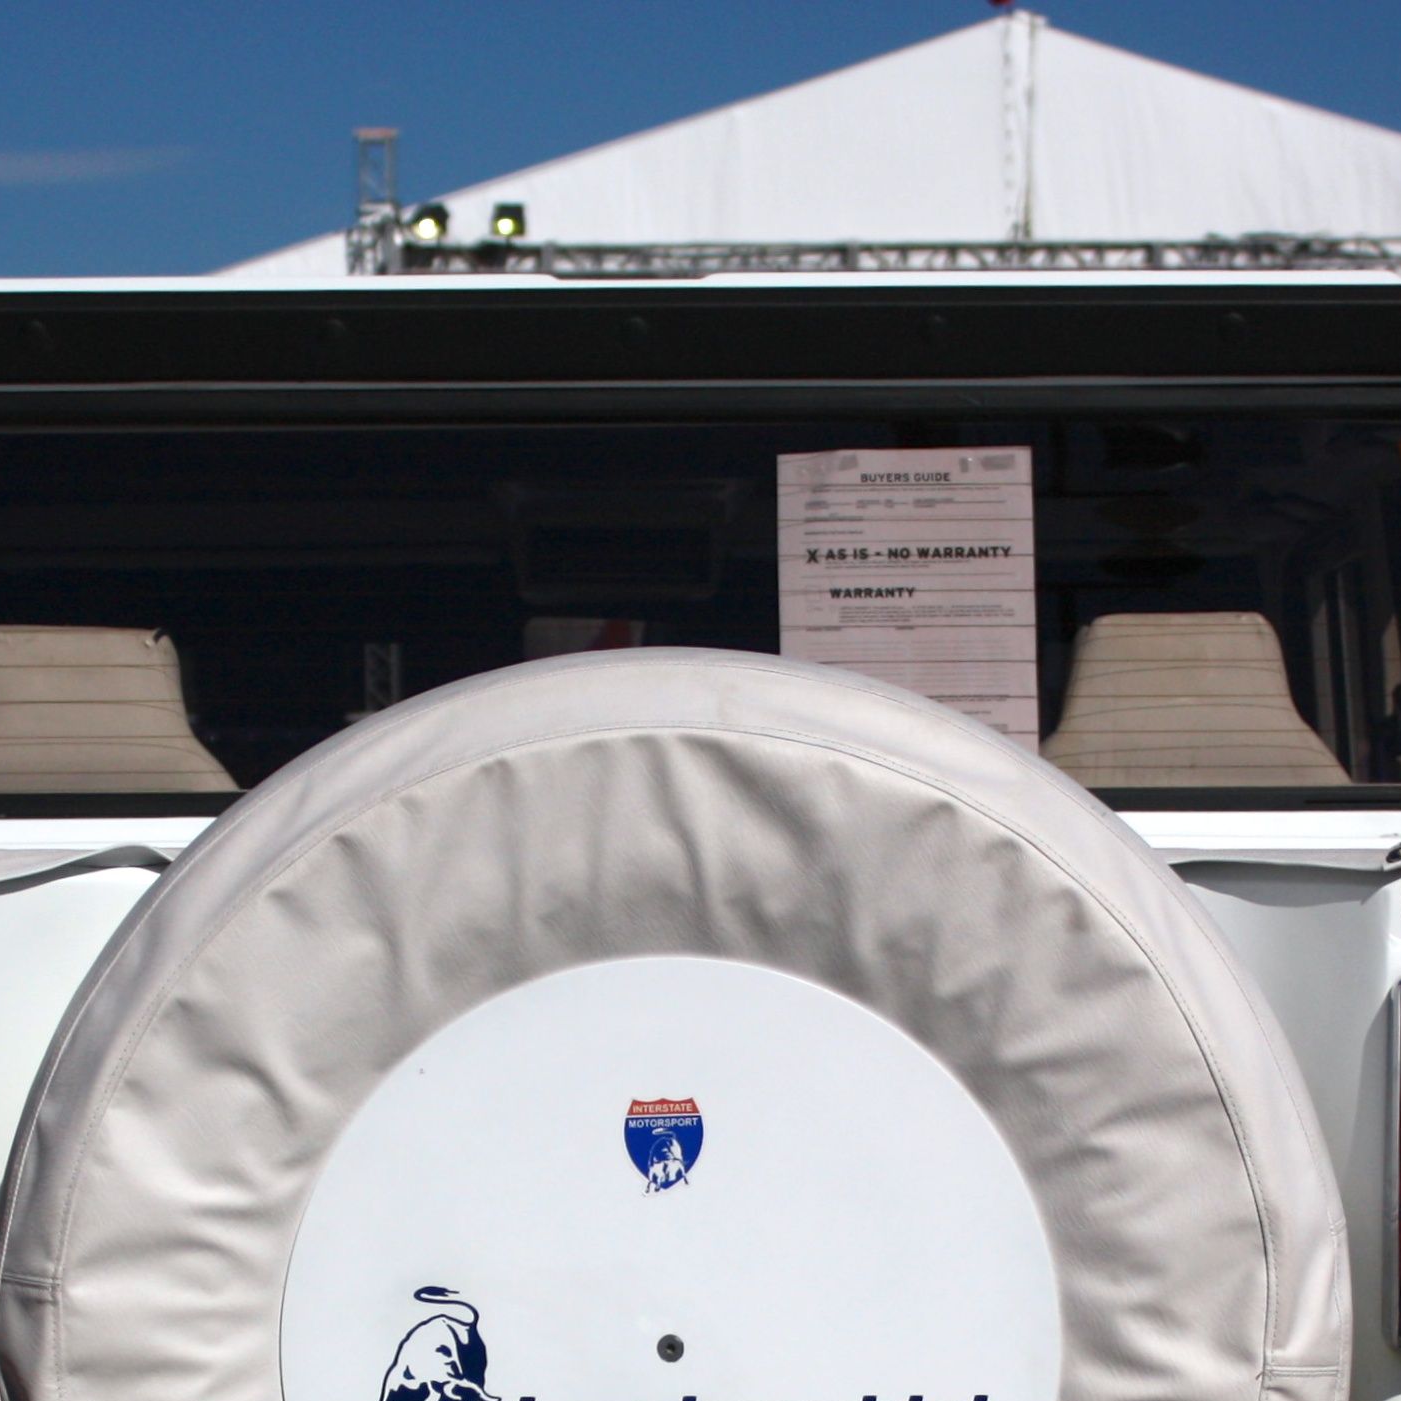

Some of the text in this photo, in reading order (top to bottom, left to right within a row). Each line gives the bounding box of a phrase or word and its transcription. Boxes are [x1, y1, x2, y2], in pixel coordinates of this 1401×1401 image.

[860, 471, 951, 483] BUYERS GUIDE
[825, 548, 847, 560] AS
[853, 548, 869, 560] IS
[887, 547, 911, 559] NO
[916, 545, 1012, 559] WARRANTY
[829, 586, 916, 599] WARRANTY
[632, 1103, 693, 1113] INTERSTATE
[628, 1117, 699, 1128] MOTORSPORT
